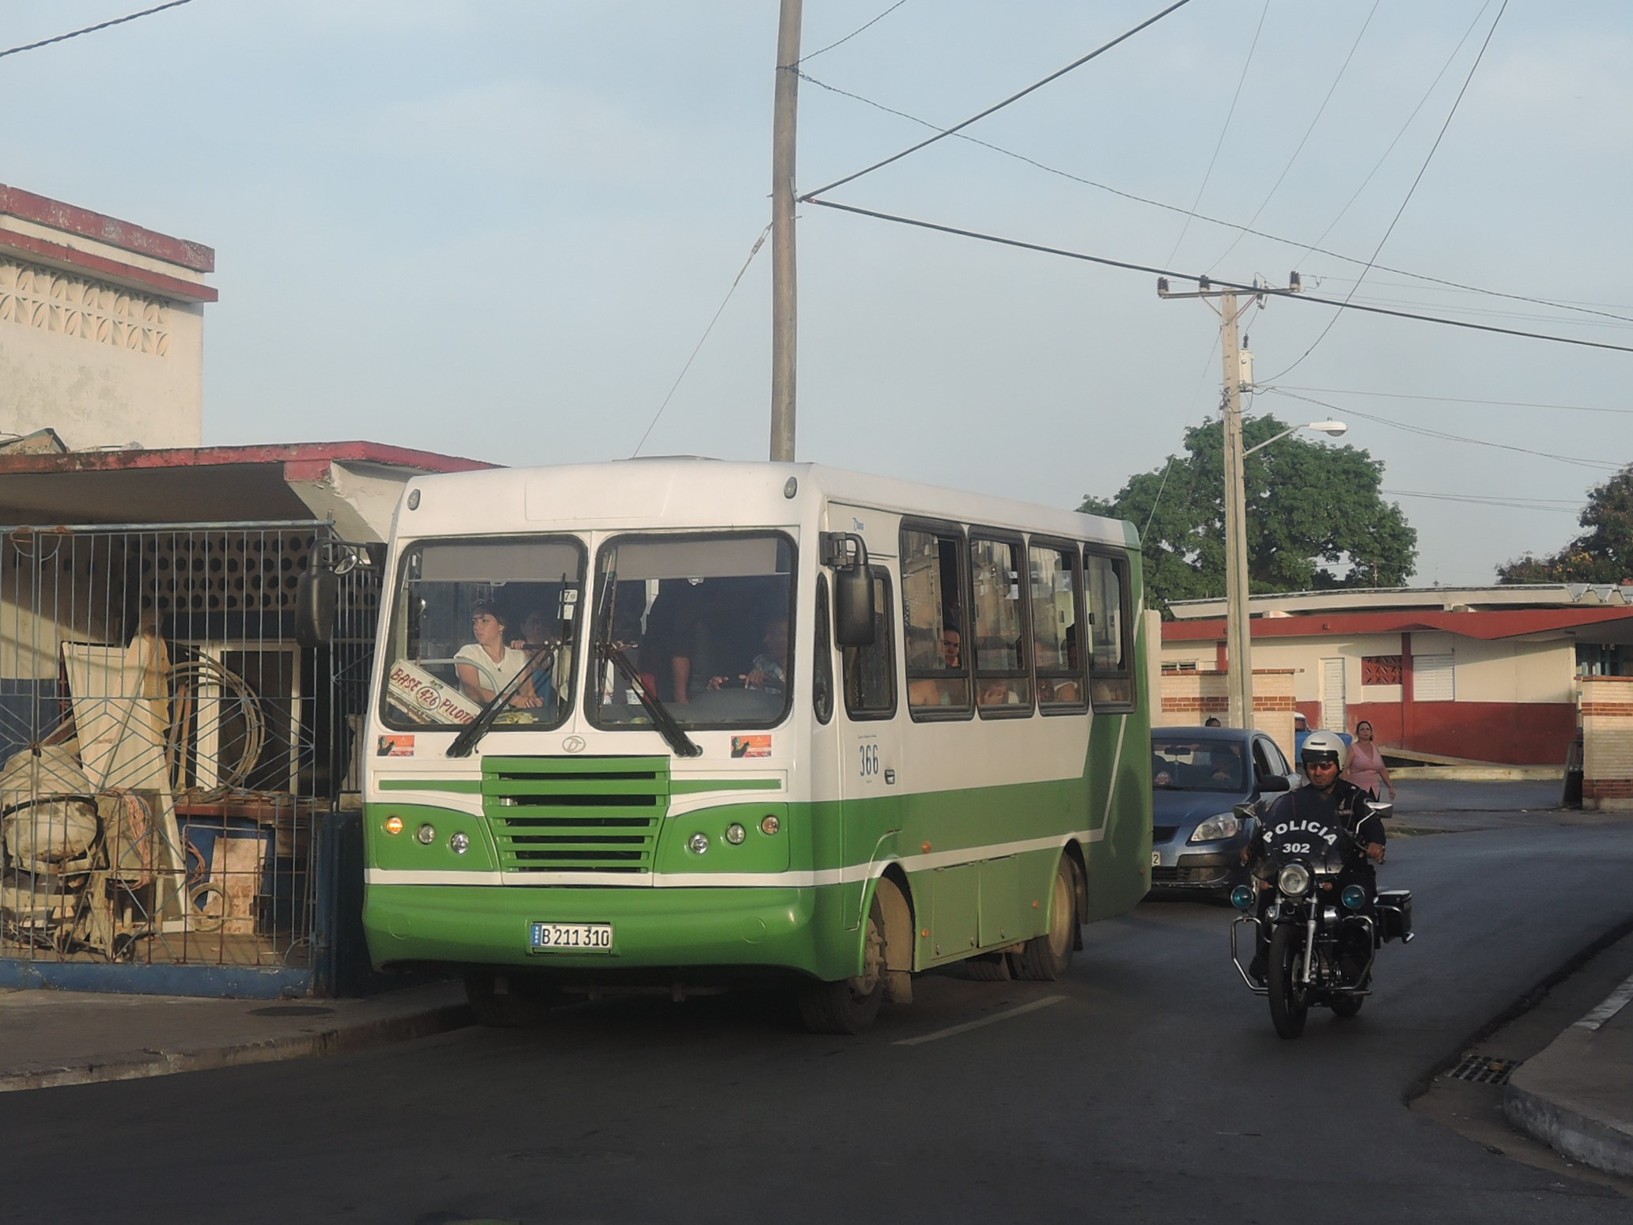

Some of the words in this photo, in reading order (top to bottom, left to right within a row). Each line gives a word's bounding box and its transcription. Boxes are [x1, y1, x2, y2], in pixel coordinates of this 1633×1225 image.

[390, 668, 422, 692] BASE
[419, 689, 439, 707] 426
[859, 744, 879, 776] 366
[1262, 819, 1338, 846] POLICIA
[1282, 843, 1311, 854] 302
